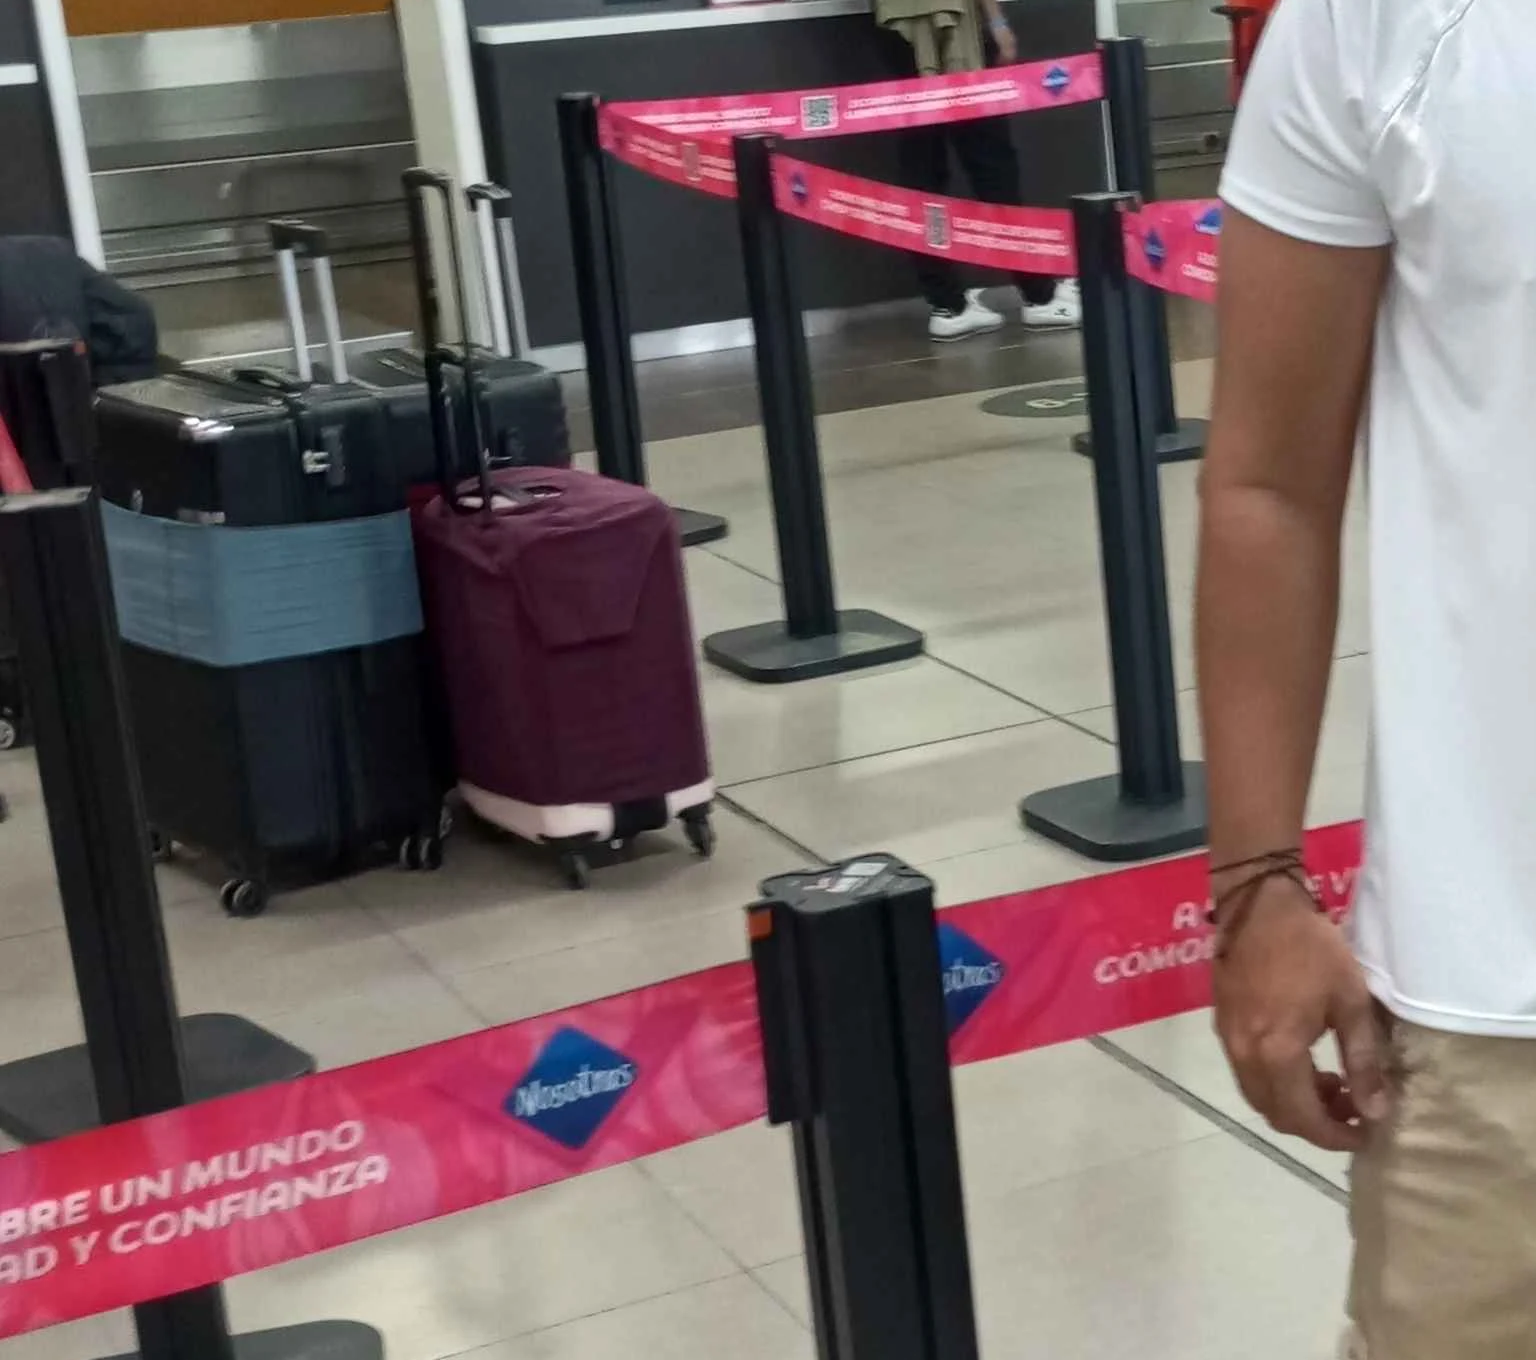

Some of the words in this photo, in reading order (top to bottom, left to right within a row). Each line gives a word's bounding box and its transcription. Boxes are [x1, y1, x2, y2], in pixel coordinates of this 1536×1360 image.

[514, 1063, 636, 1117] Nosotras
[69, 1230, 101, 1267] Y
[108, 1153, 390, 1256] CONFIANZA
[98, 1168, 176, 1216] UN
[181, 1119, 366, 1196] MUNDO
